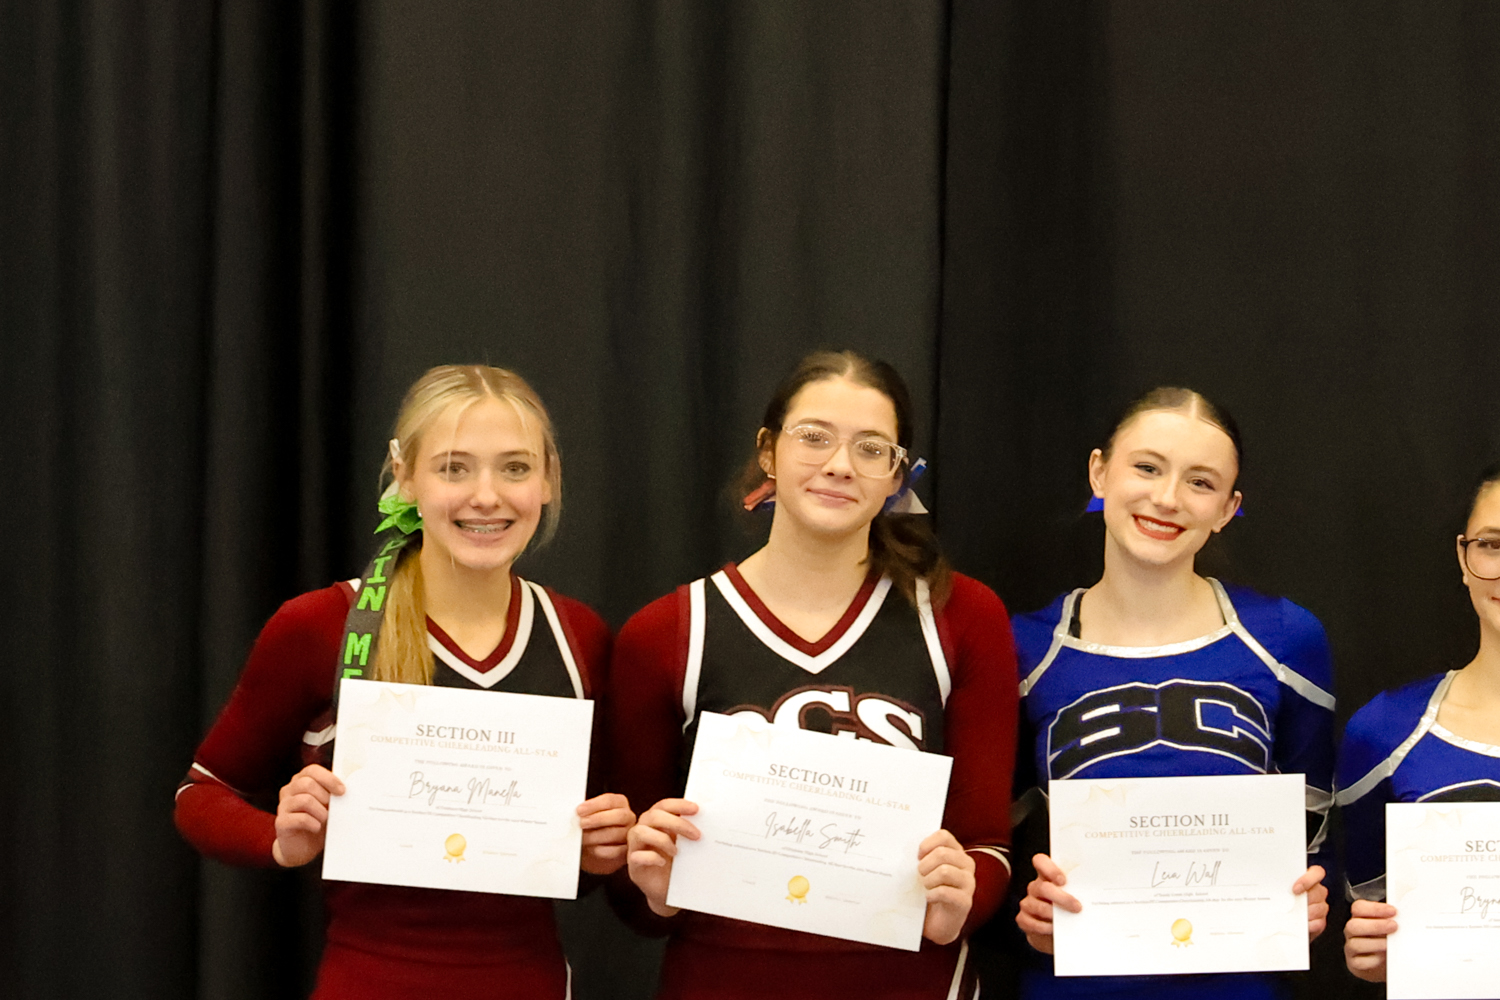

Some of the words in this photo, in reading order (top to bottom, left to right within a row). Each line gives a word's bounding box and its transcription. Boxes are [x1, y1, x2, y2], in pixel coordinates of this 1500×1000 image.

[341, 632, 372, 678] M
[722, 684, 927, 752] CS
[1048, 678, 1271, 780] SC
[370, 735, 436, 748] COMPETITIVE
[438, 740, 511, 754] CHEERLEADING
[513, 747, 559, 758] ALL-STAR
[416, 724, 492, 742] SECTION
[496, 730, 516, 745] III
[722, 769, 788, 788] COMPETITIVE
[789, 781, 863, 803] CHEERLEADING
[865, 797, 910, 812] ALL-STAR
[767, 763, 845, 788] SECTION
[850, 779, 869, 794] III
[764, 811, 815, 843] Isabella
[819, 823, 865, 854] Smith
[1084, 830, 1150, 839] COMPETITIVE
[1152, 828, 1227, 837] CHEERLEADING
[1229, 827, 1275, 835] ALL-STAR
[1129, 814, 1205, 828] SECTION
[1211, 813, 1230, 826] III
[1420, 854, 1486, 863] COMPETITIVE
[1185, 860, 1221, 886] Wall
